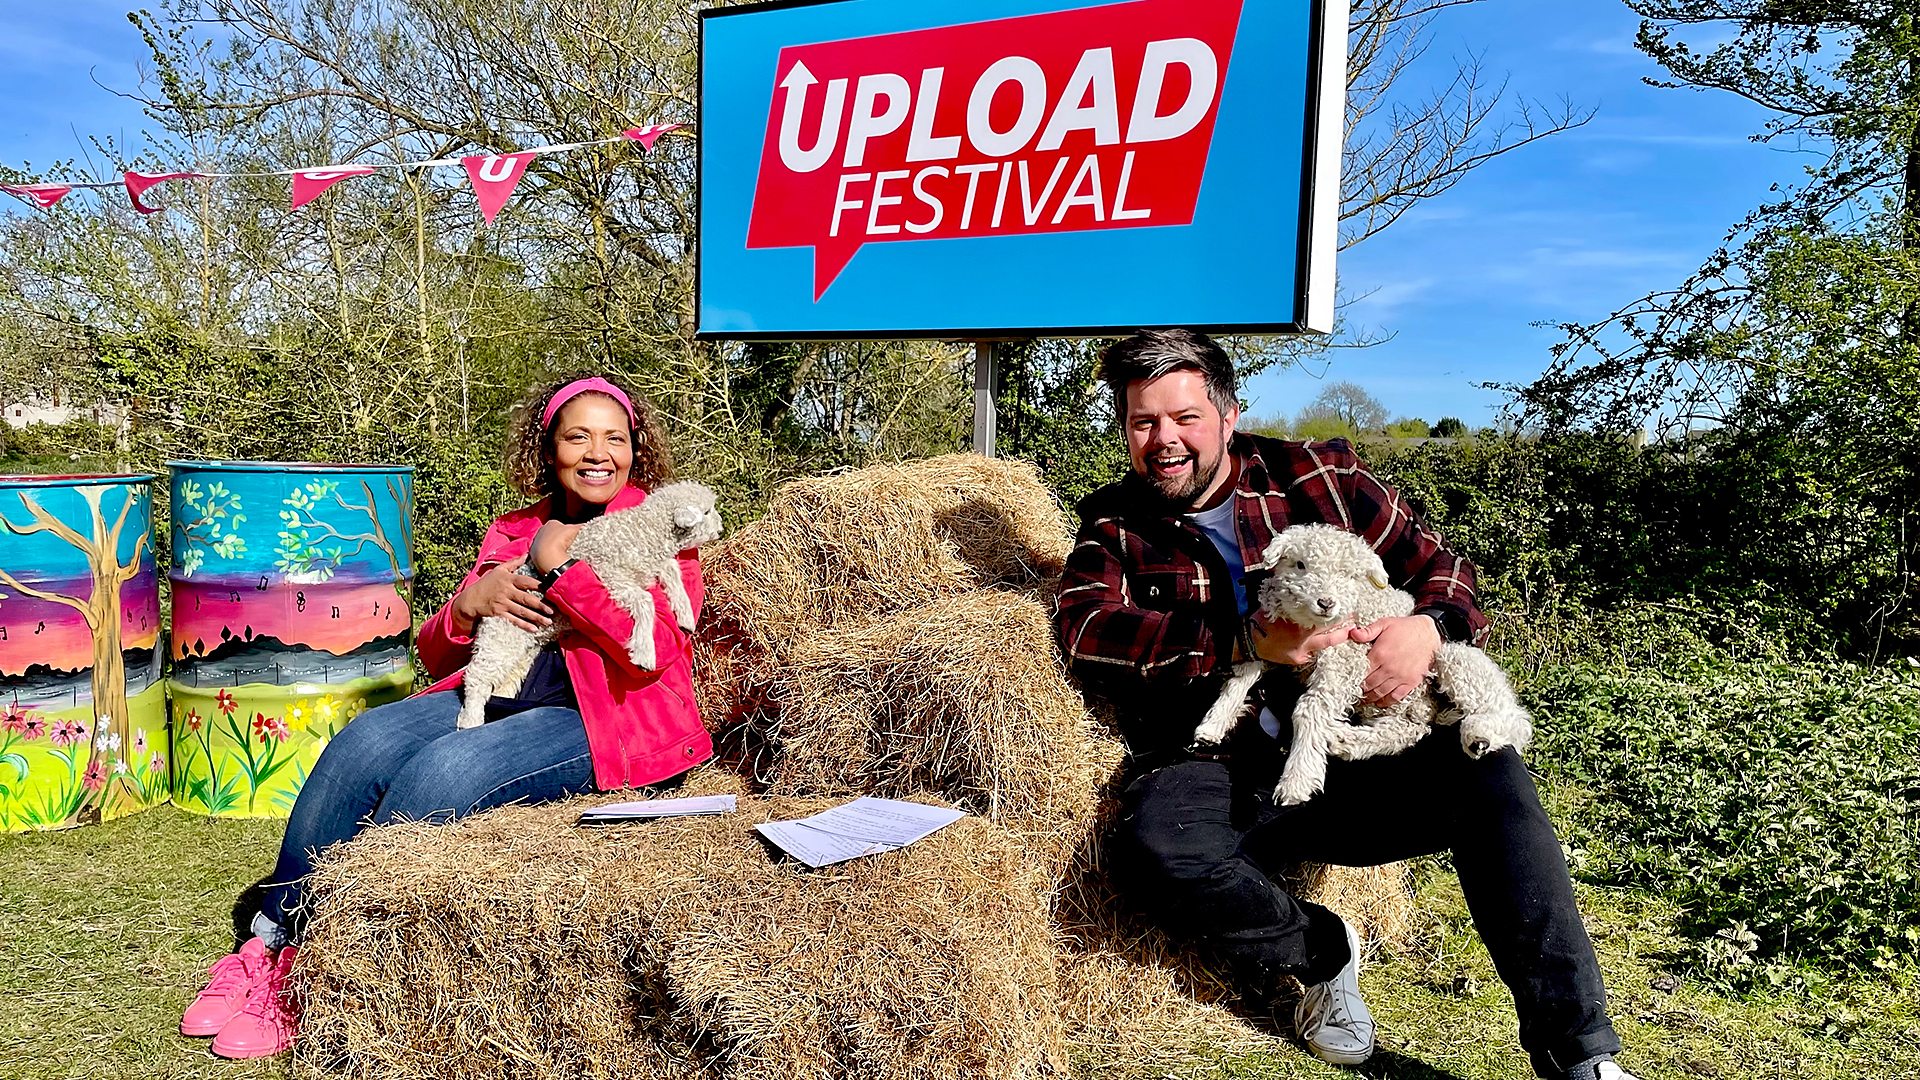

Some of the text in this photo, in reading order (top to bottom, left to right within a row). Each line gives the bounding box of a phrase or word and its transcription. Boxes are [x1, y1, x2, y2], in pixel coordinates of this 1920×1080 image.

[779, 38, 1217, 173] UPLOAD
[480, 155, 518, 182] U
[830, 151, 1151, 237] FESTIVAL
